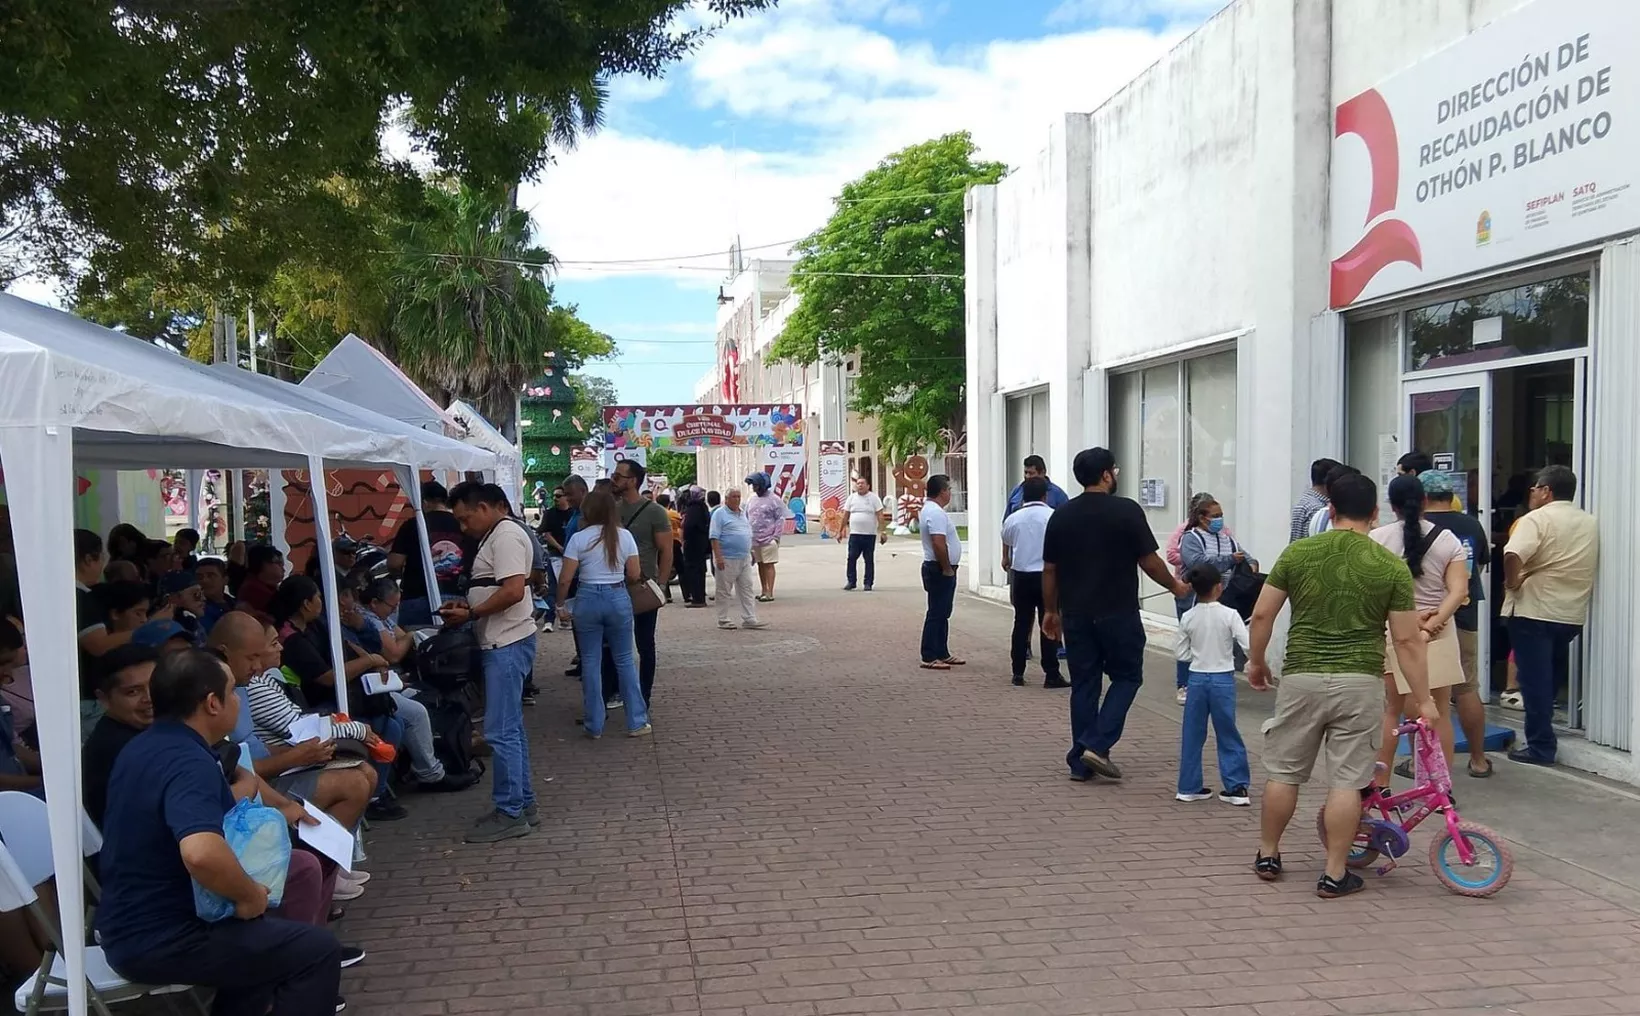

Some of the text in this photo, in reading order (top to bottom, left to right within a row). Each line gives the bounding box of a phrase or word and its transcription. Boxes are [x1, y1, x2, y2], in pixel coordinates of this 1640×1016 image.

[1437, 33, 1590, 124] DIRECCIÓN DE
[1419, 66, 1611, 167] RECAUDACIÓN DE
[1416, 111, 1612, 203] OTHÓN P. BLANCO
[1526, 192, 1565, 211] SEFIPLAN
[1573, 182, 1596, 197] SATQ
[676, 427, 731, 438] DULCE NAVIDAD
